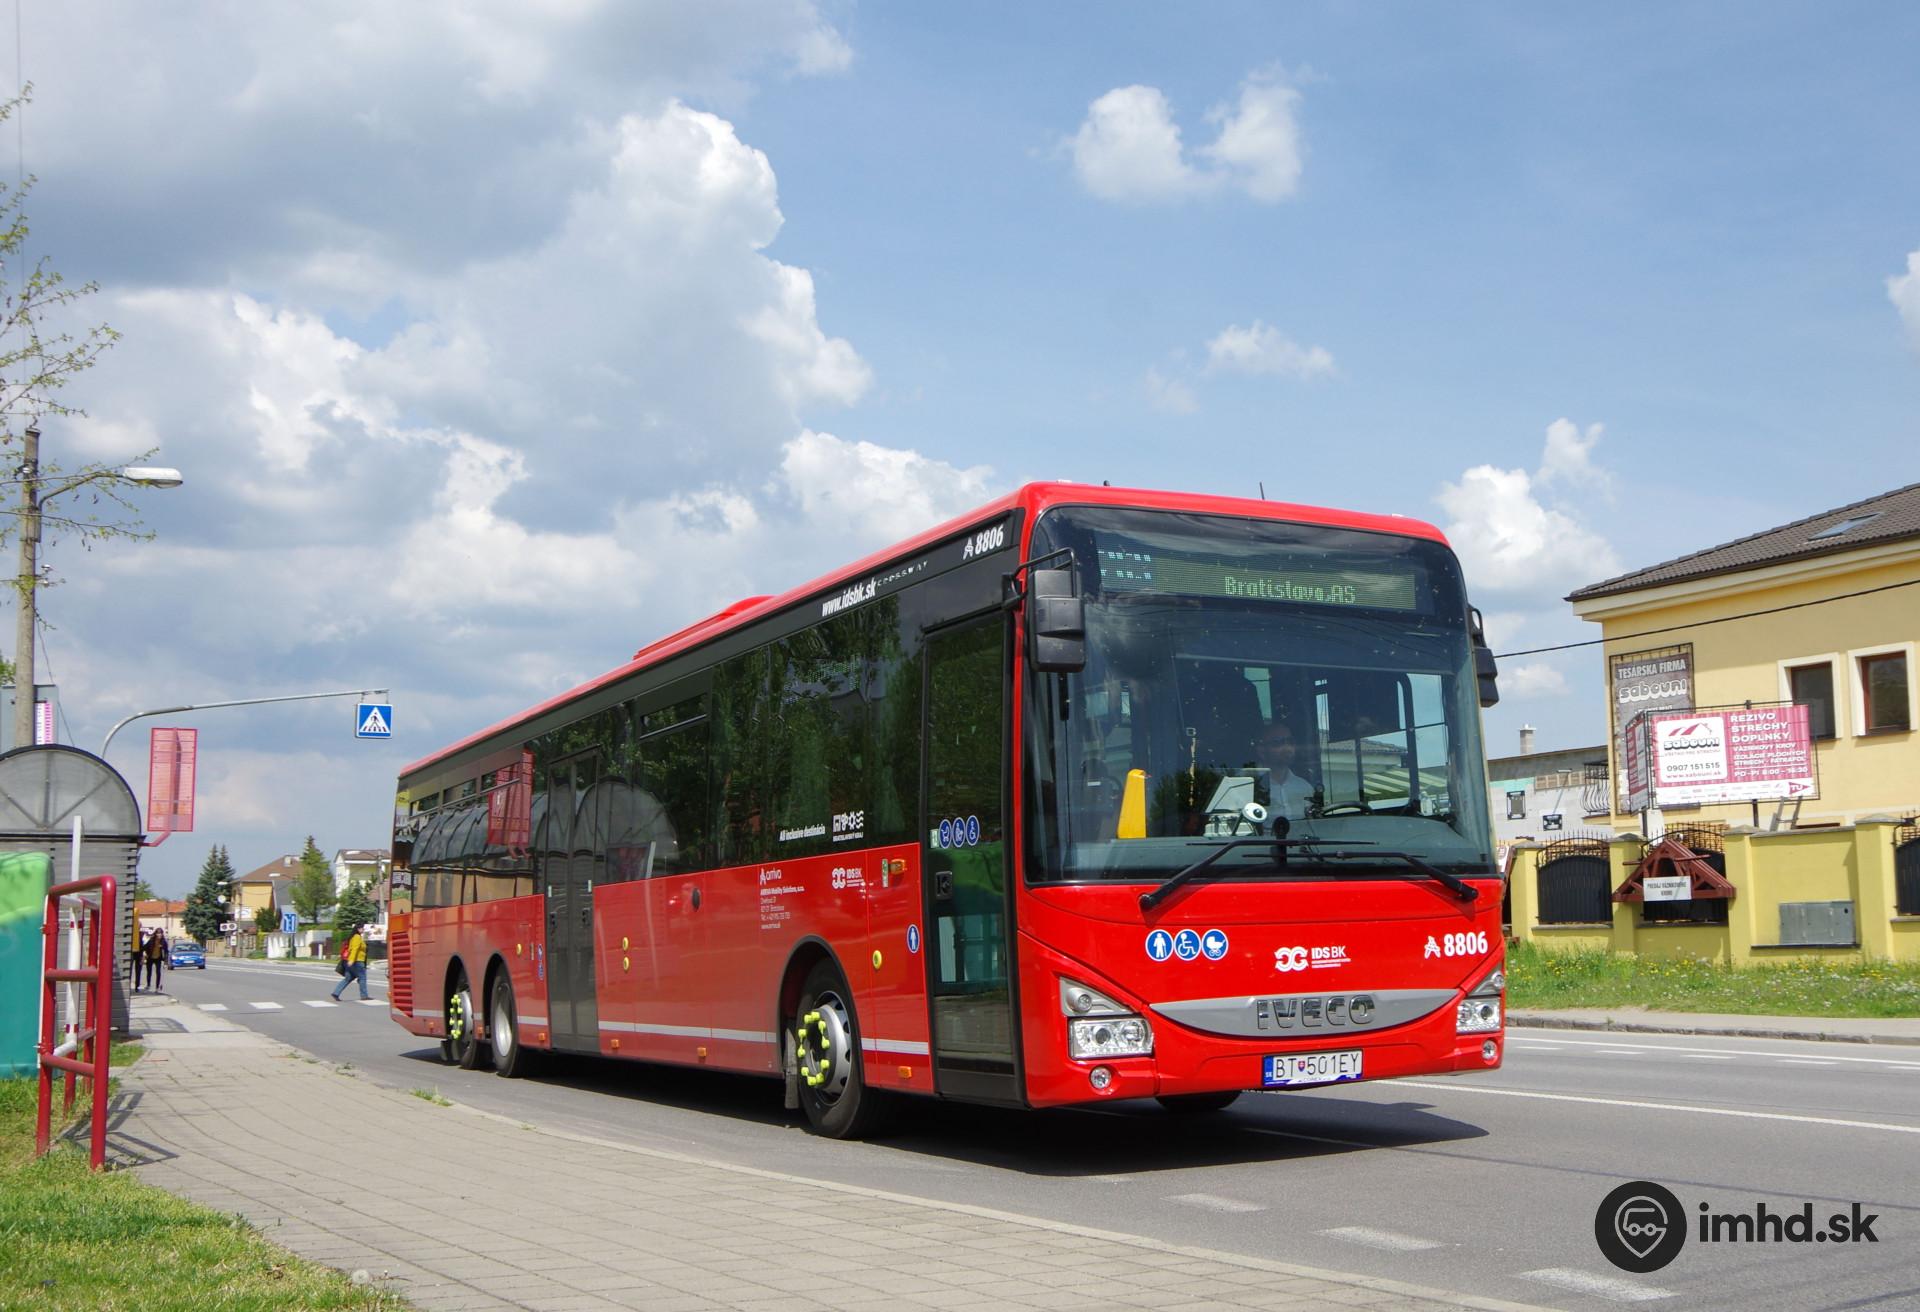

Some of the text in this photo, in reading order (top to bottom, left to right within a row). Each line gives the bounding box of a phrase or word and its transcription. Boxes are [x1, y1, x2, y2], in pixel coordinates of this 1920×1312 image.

[975, 524, 1004, 555] 8806
[822, 576, 877, 617] www.idsbk.sk
[1659, 659, 1687, 674] FIRMA
[1730, 713, 1776, 722] REZIVO
[1731, 722, 1788, 733] STRECHY
[1732, 732, 1790, 743] DOPLNKY
[1666, 764, 1688, 772] 0907
[1443, 931, 1489, 957] 8806
[1256, 994, 1377, 1031] IVECO
